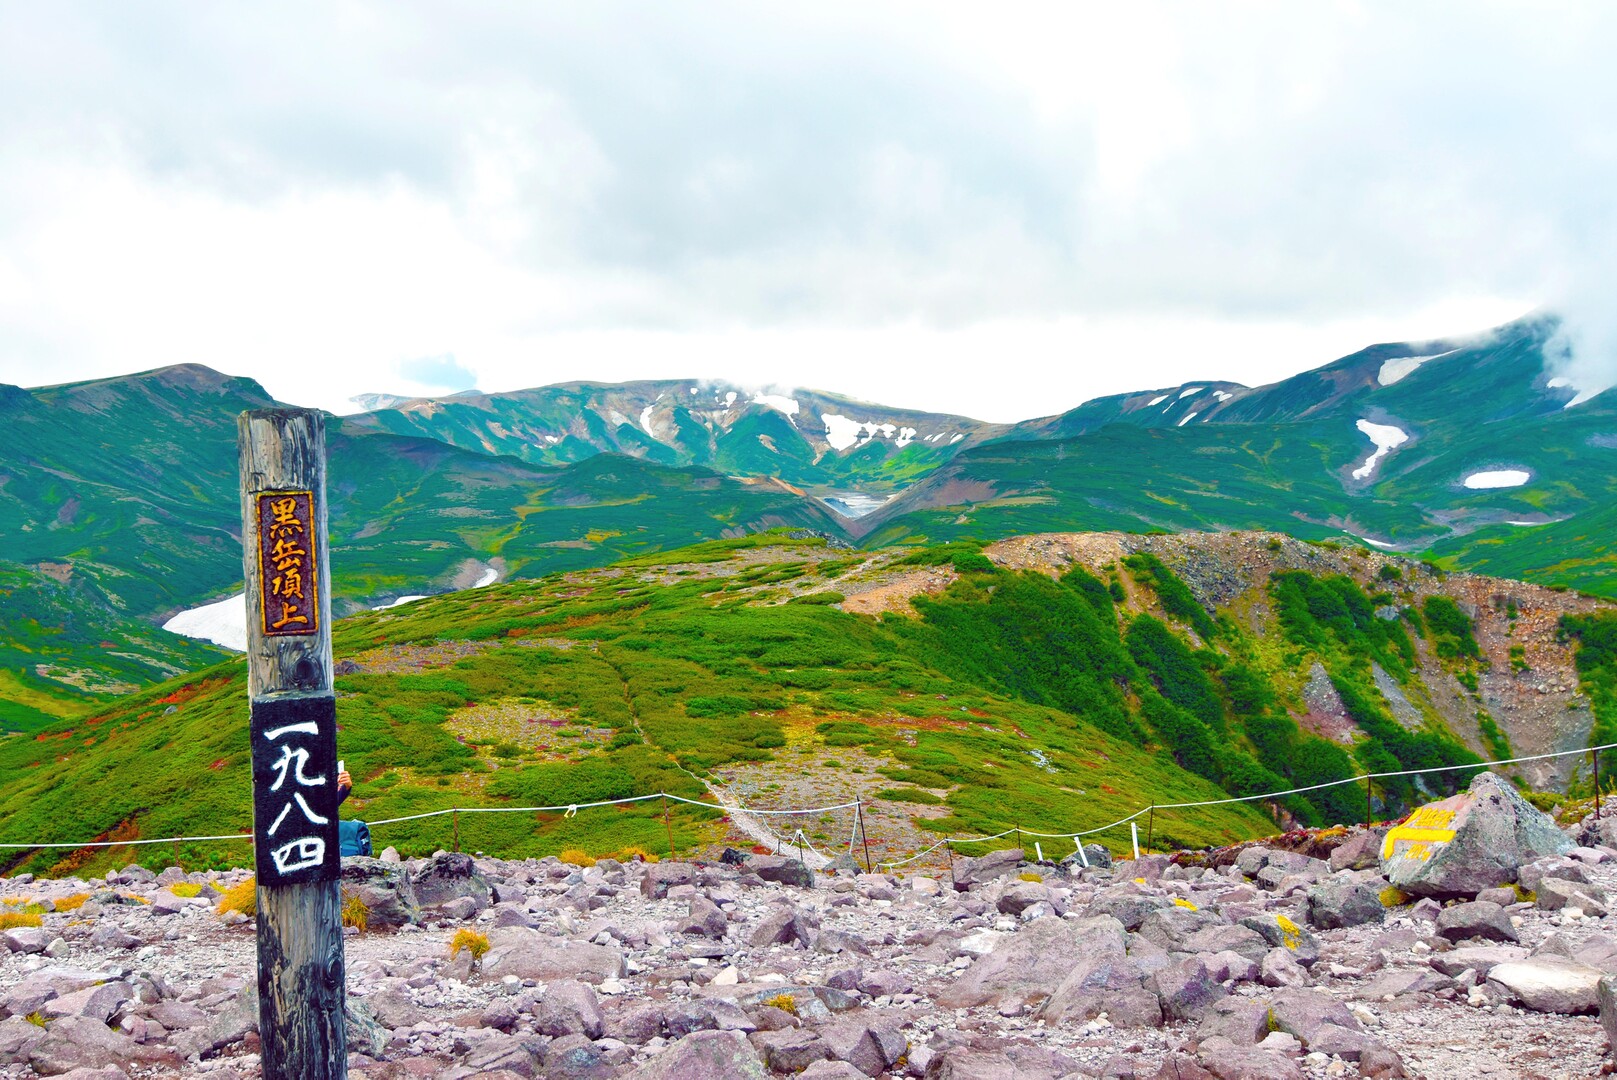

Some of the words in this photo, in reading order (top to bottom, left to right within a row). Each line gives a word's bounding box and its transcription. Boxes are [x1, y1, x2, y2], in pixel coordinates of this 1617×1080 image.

[270, 497, 308, 629] 黒岳頂上
[263, 721, 328, 875] 一九八四
